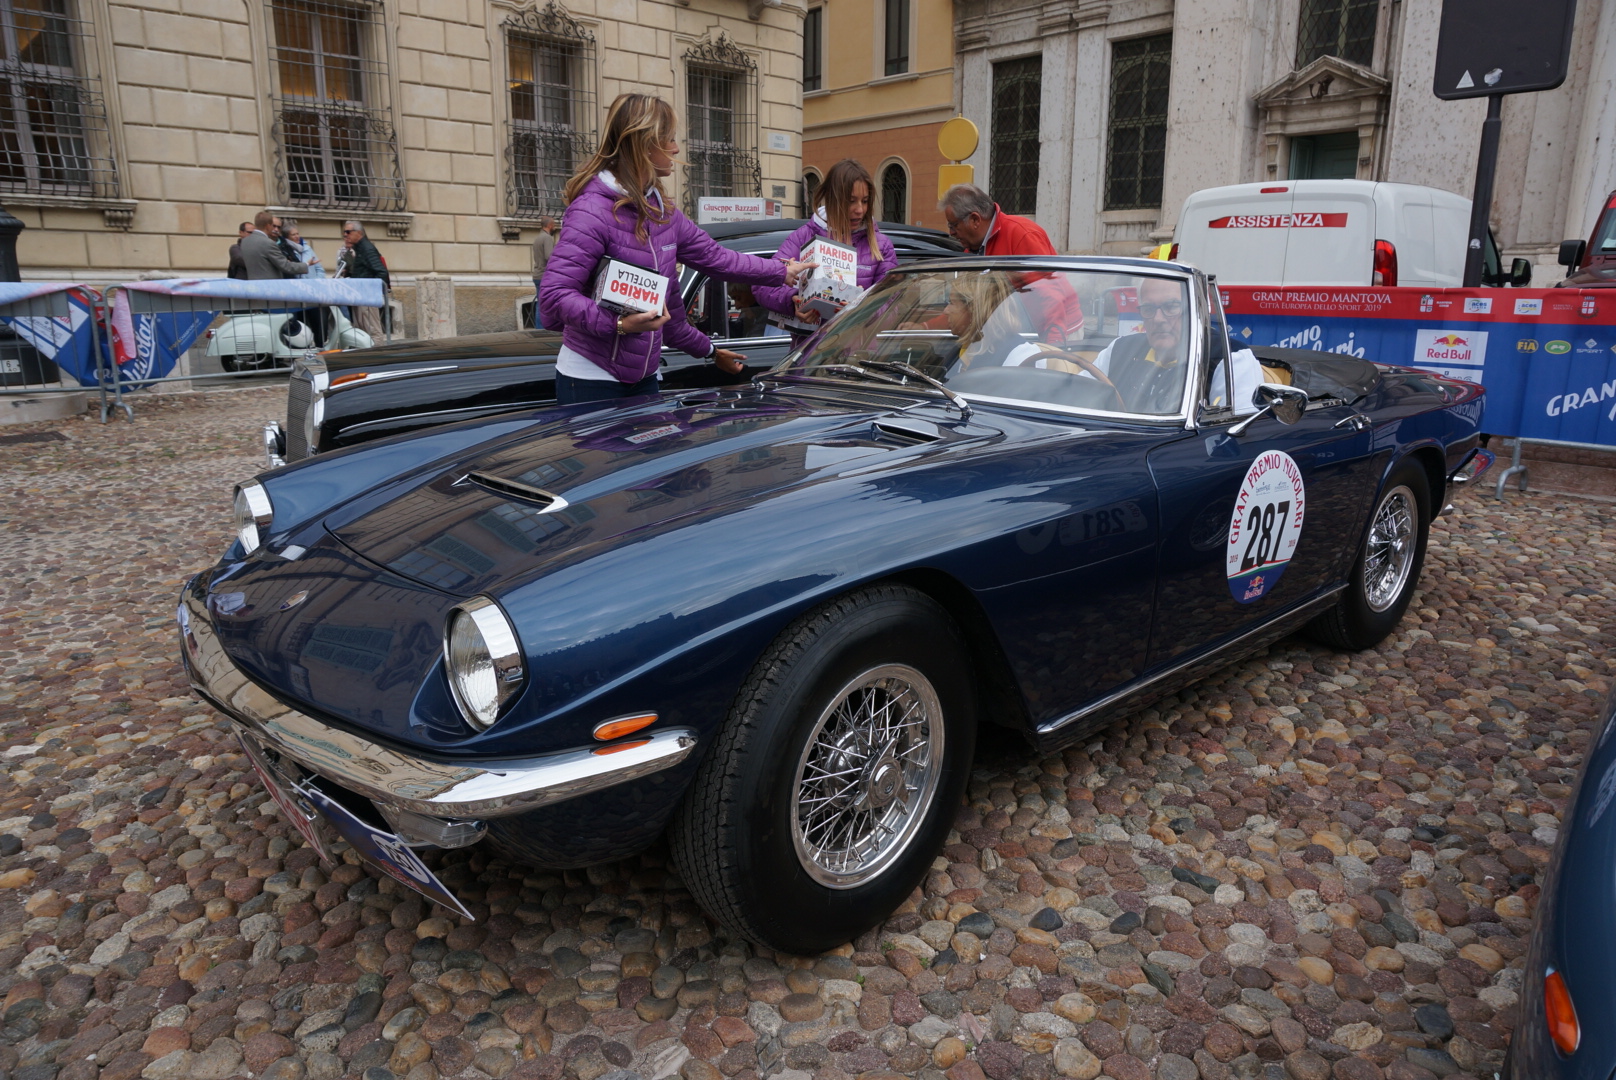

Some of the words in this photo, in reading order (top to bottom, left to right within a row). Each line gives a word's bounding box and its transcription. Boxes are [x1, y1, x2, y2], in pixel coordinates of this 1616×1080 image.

[703, 203, 733, 213] Giuseppe
[735, 204, 760, 212] Bazzani
[1226, 213, 1323, 228] ASSISTENZA
[819, 244, 854, 263] HARIBO
[821, 255, 851, 271] ROTELLA
[618, 269, 658, 290] ROTELLA
[610, 279, 660, 306] HARIBO
[1252, 292, 1283, 301] GRAN
[1286, 293, 1329, 302] PREMIO
[1331, 293, 1392, 304] MANTOVA
[1427, 348, 1449, 359] Red
[1450, 349, 1471, 361] Bull
[1545, 379, 1616, 417] GRAN
[1230, 488, 1249, 545] GRAN
[1247, 454, 1281, 489] PREMIO
[1282, 458, 1303, 529] NUVOLARI
[1240, 500, 1290, 572] 287
